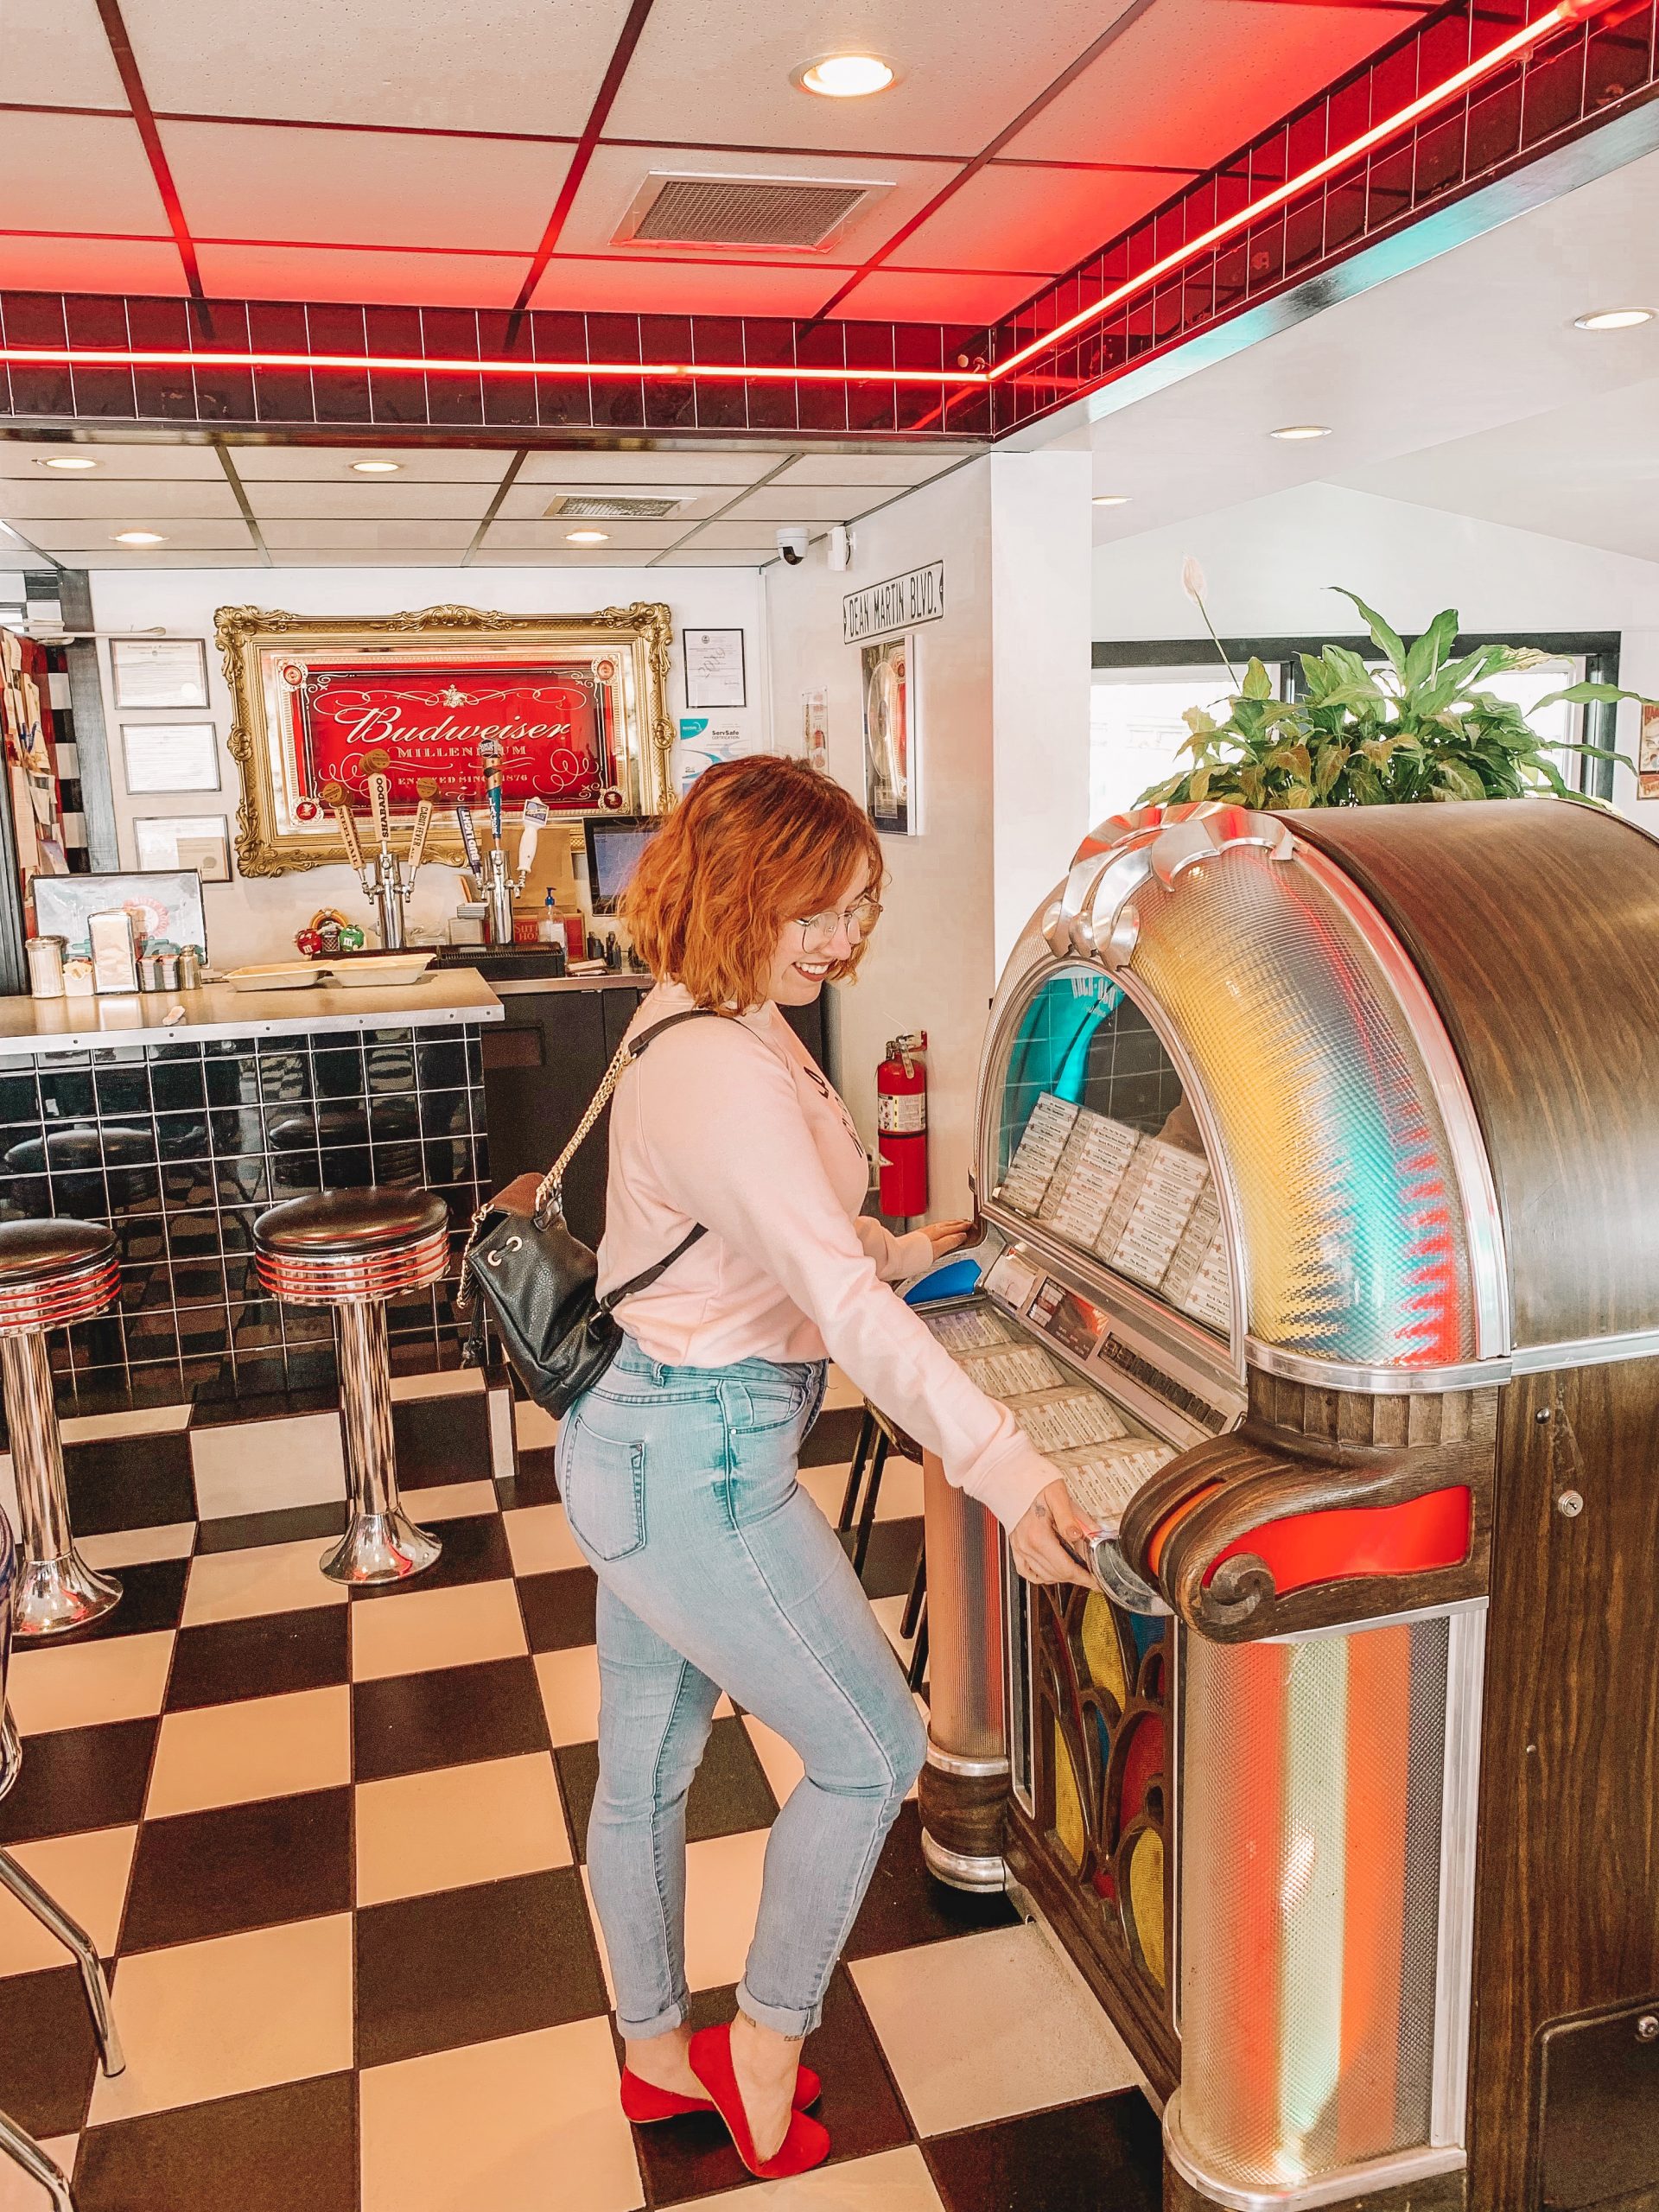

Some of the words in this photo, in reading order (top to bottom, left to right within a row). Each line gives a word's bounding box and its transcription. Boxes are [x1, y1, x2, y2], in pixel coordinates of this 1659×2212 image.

[849, 594, 869, 638] DEAN
[874, 581, 905, 630] MARTIN
[910, 570, 937, 620] BLVD.
[334, 705, 572, 744] Budweiser
[397, 744, 527, 759] MILLENUM
[376, 777, 390, 838] SHABADOO
[461, 810, 475, 839] LIGHT
[488, 797, 500, 835] LAGER
[467, 839, 481, 861] BUD
